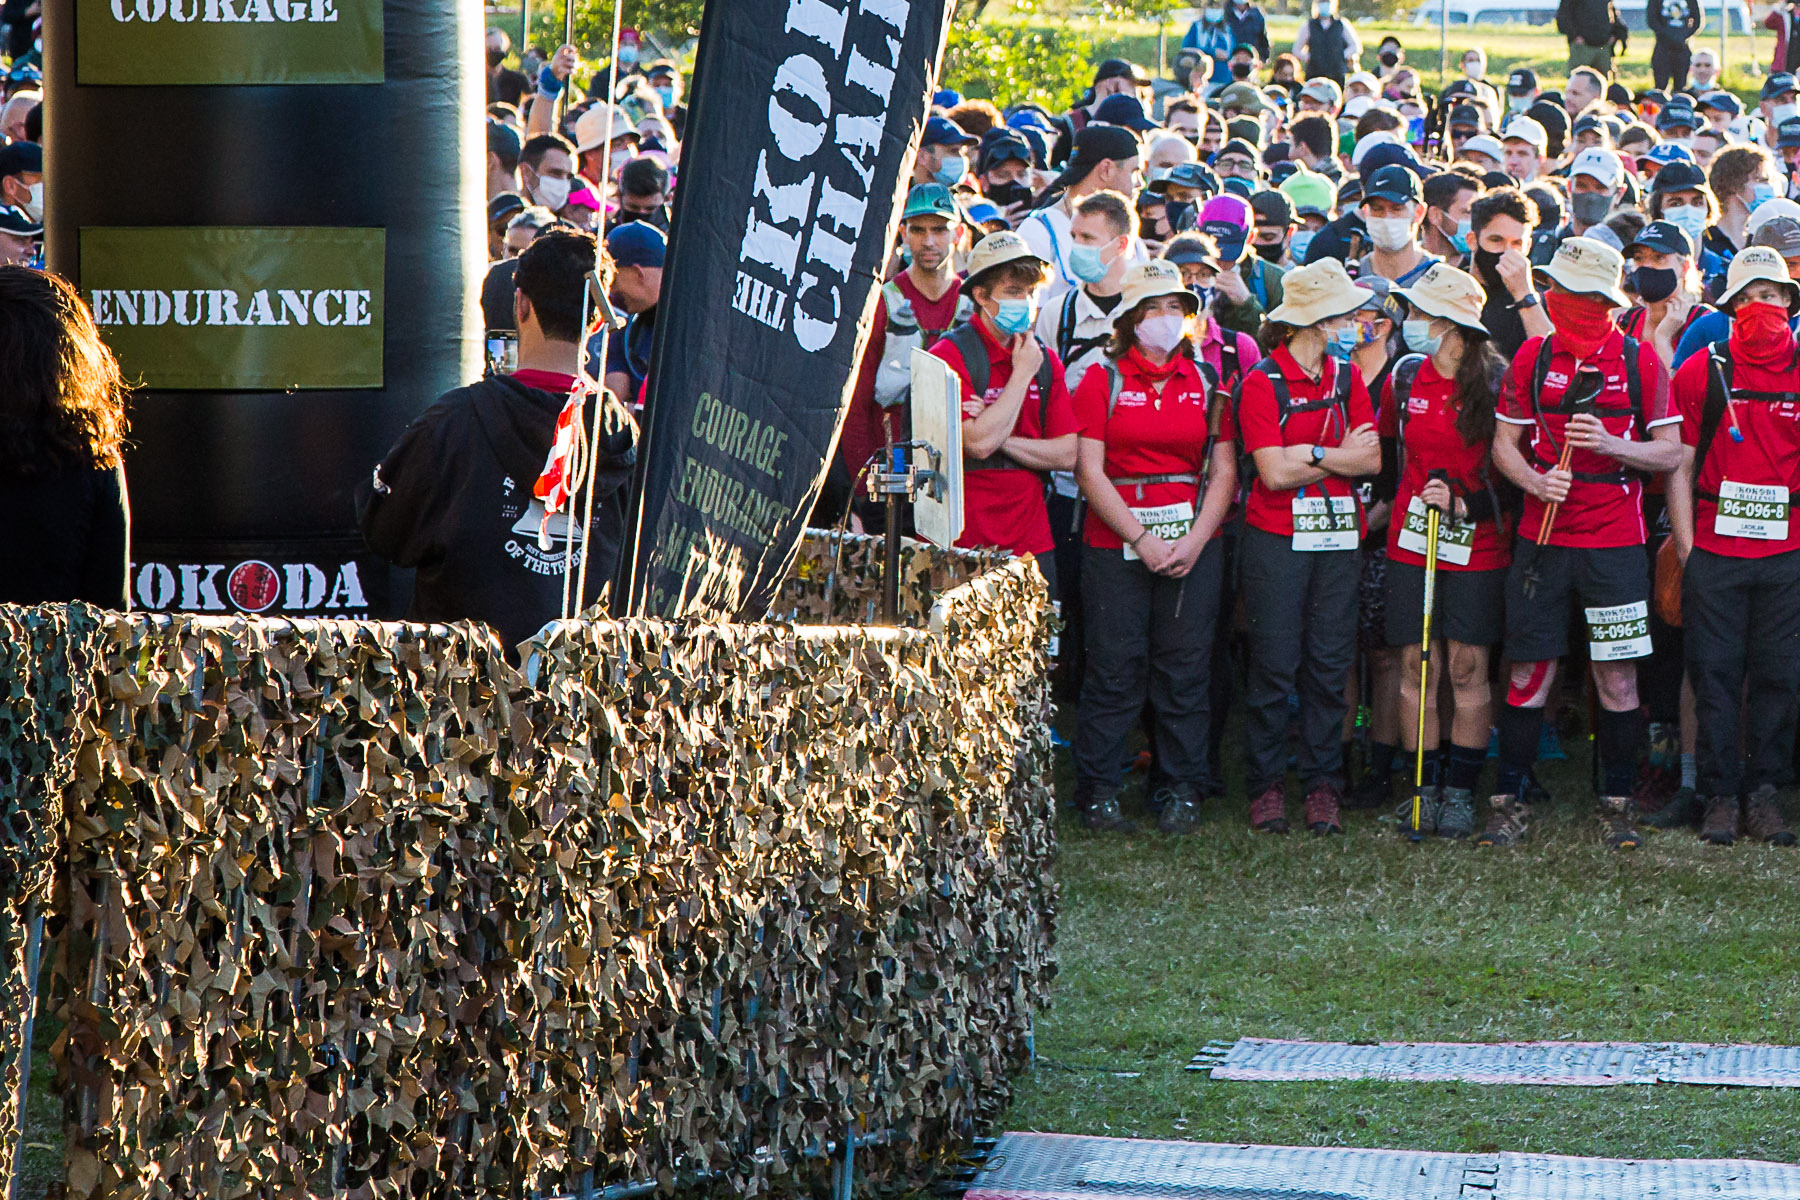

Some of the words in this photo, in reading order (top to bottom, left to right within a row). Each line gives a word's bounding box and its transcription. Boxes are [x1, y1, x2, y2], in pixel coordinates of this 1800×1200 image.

[91, 289, 373, 327] ENDURANCE
[732, 270, 787, 332] THE
[1299, 514, 1354, 531] 96-06-11
[1723, 499, 1785, 519] 96-096-8
[1146, 520, 1190, 539] -096-1
[1408, 514, 1470, 544] 96-96-7
[504, 539, 525, 560] OF
[523, 553, 551, 576] THE
[130, 560, 369, 613] OKODA
[1592, 619, 1647, 640] 96-096-15
